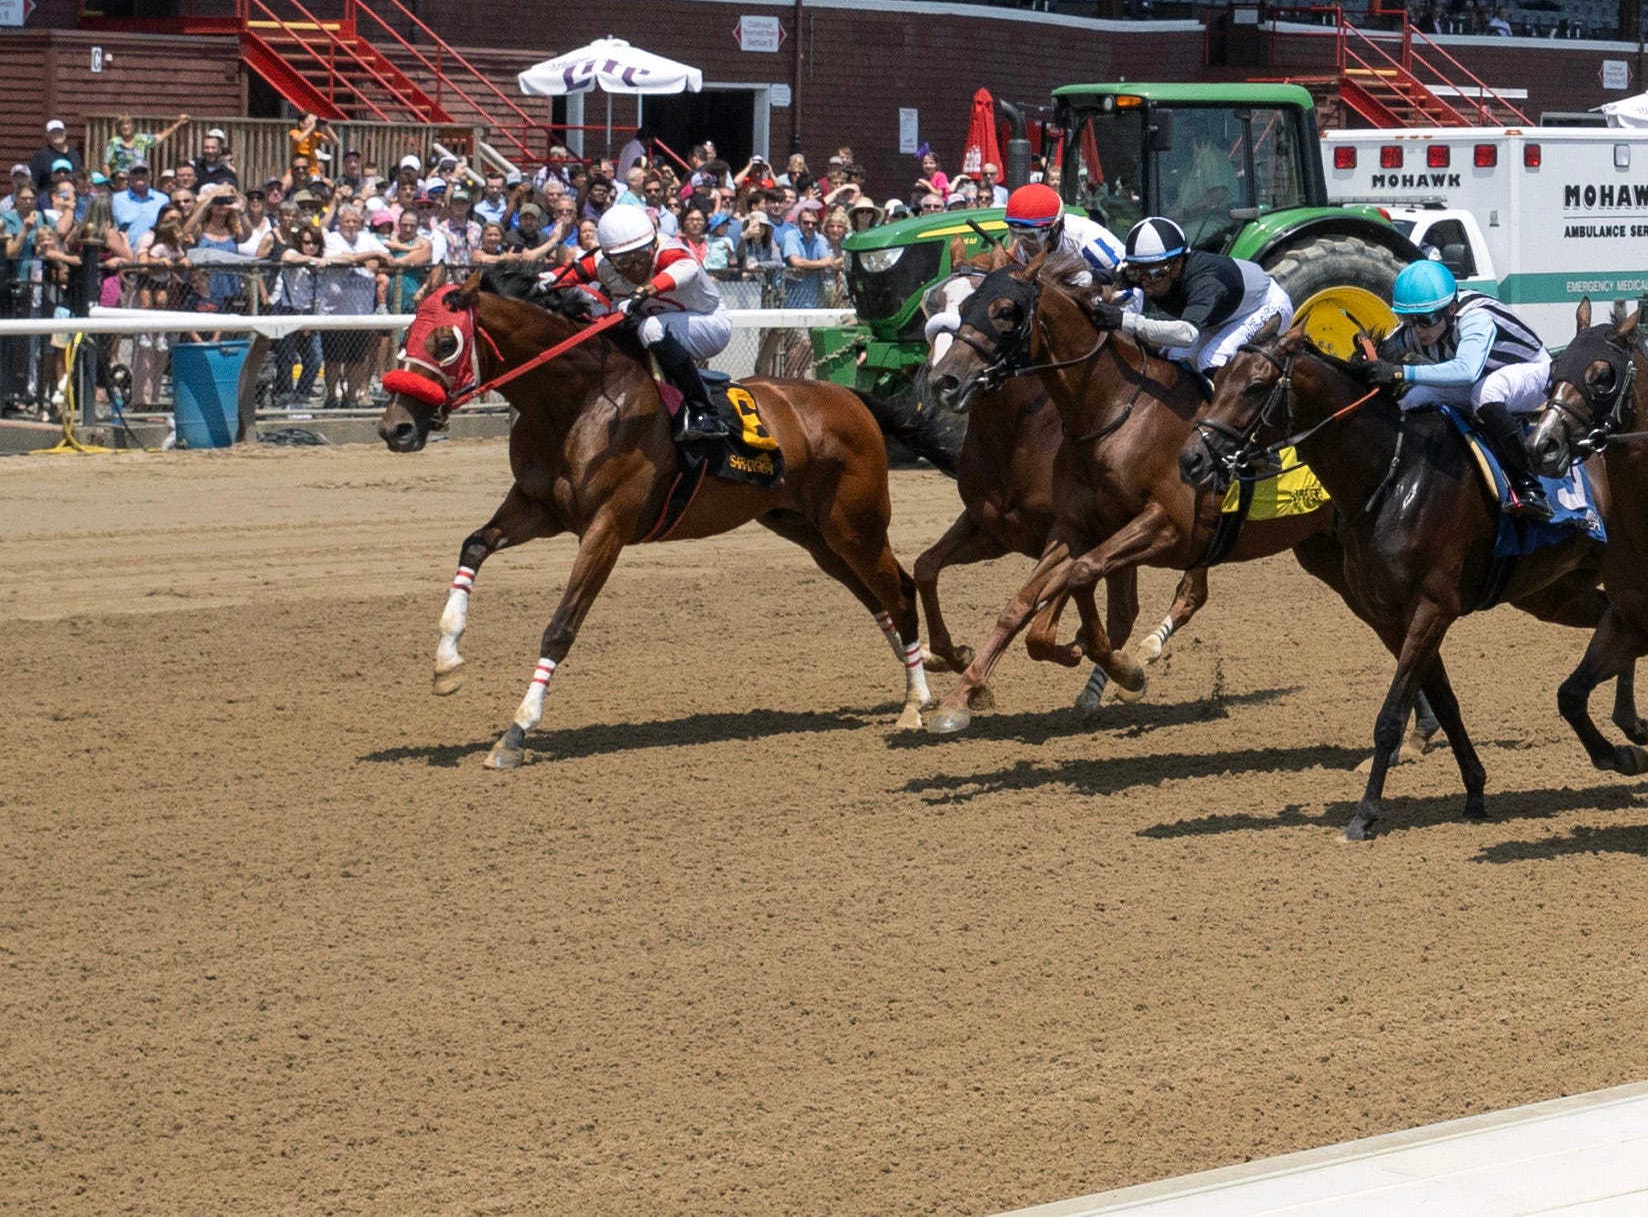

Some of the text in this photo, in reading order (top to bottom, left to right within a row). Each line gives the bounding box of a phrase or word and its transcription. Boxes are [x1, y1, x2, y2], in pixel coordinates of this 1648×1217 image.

[1371, 173, 1461, 189] MOHAWK
[1564, 225, 1626, 239] AMBULANCE
[1566, 281, 1615, 294] EMERGENCY
